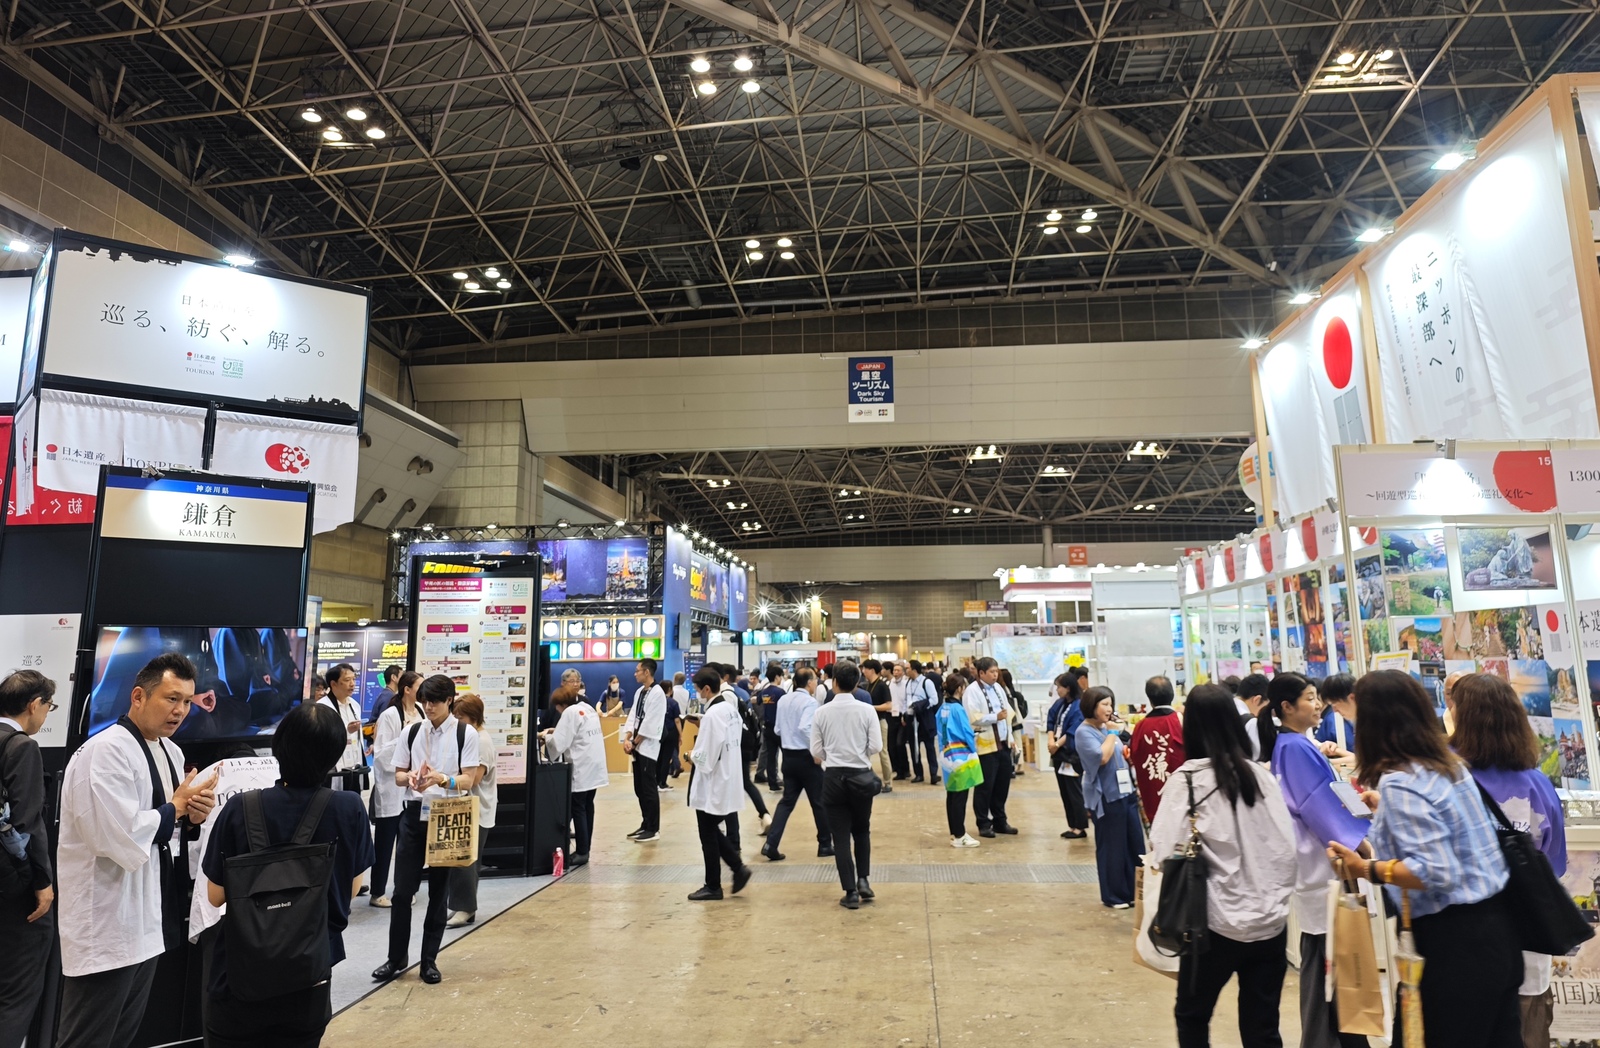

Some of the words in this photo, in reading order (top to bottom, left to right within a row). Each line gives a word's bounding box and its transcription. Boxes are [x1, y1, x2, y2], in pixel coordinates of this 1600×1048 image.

[1427, 251, 1464, 384] ニッポンの
[185, 367, 215, 376] TOURISM
[861, 371, 881, 380] 星空
[852, 380, 890, 390] ツーリズム
[62, 447, 106, 461] 日本遺産
[1538, 457, 1551, 466] 15
[196, 484, 230, 494] 神奈川県
[182, 502, 237, 526] 鎌倉
[179, 529, 236, 539] KAMAKURA
[22, 655, 43, 667] 巡る
[438, 812, 471, 828] DEATH
[437, 826, 471, 842] EATER
